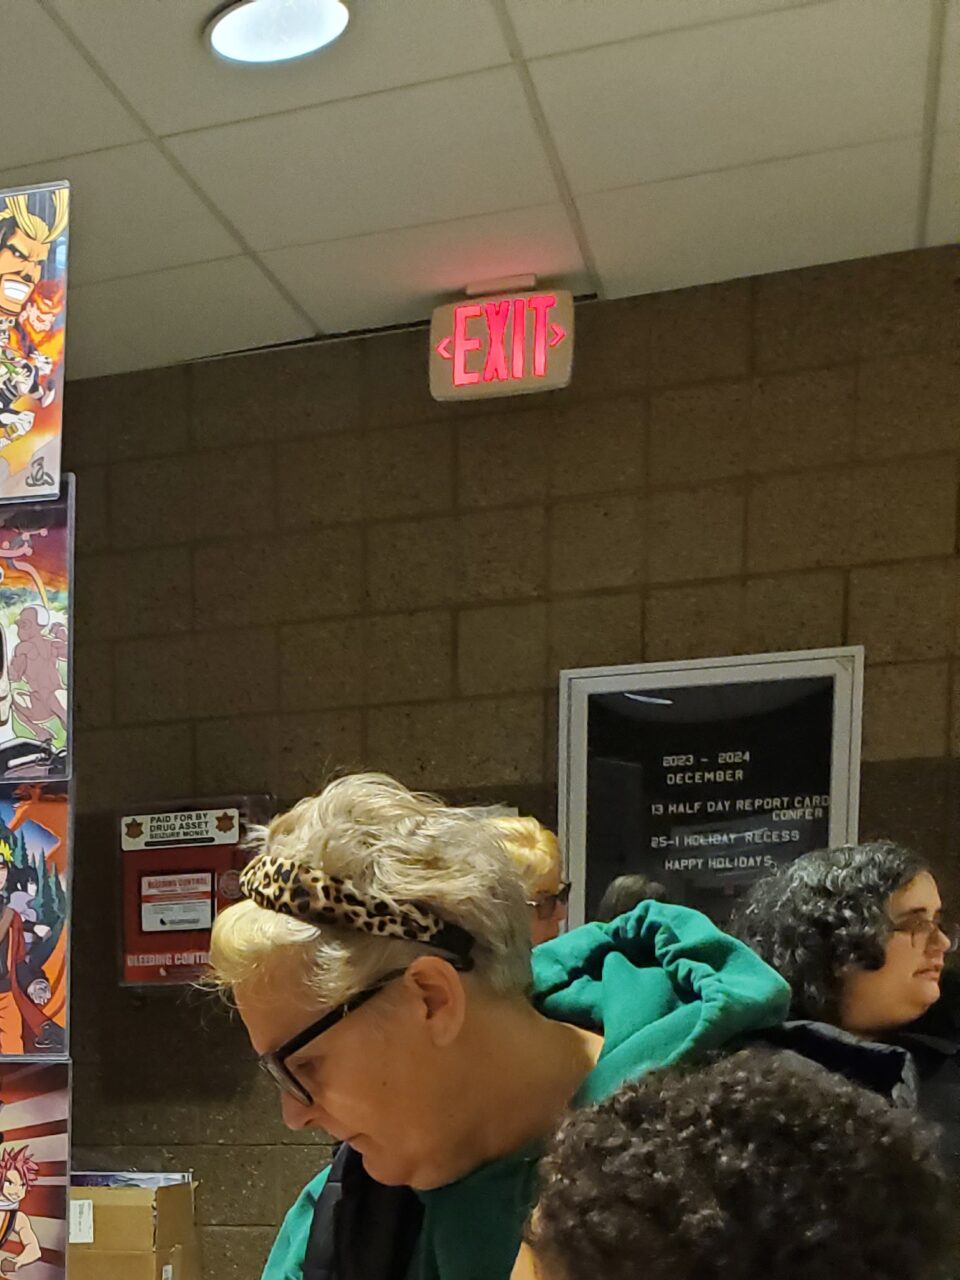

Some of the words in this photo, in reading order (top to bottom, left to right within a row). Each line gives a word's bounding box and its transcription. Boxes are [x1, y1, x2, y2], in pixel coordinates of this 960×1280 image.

[453, 295, 556, 387] EXIT
[662, 755, 694, 767] 2023
[718, 750, 751, 764] 2024
[666, 769, 744, 785] DECEMBER
[651, 804, 664, 815] 13
[668, 802, 702, 814] HALF
[707, 800, 731, 812] DAY
[736, 797, 790, 811] REPORT
[794, 795, 830, 808] CARD
[150, 816, 171, 824] PAID
[174, 814, 193, 822] FOR
[195, 812, 208, 820] BY
[772, 808, 823, 821] CONFER
[150, 823, 176, 832] DRUG
[178, 821, 209, 830] ASSET
[684, 833, 736, 847] HOLIDAY
[745, 830, 800, 844] RECESS
[665, 858, 704, 871] HAPPY
[708, 855, 772, 870] HOLIDAYS
